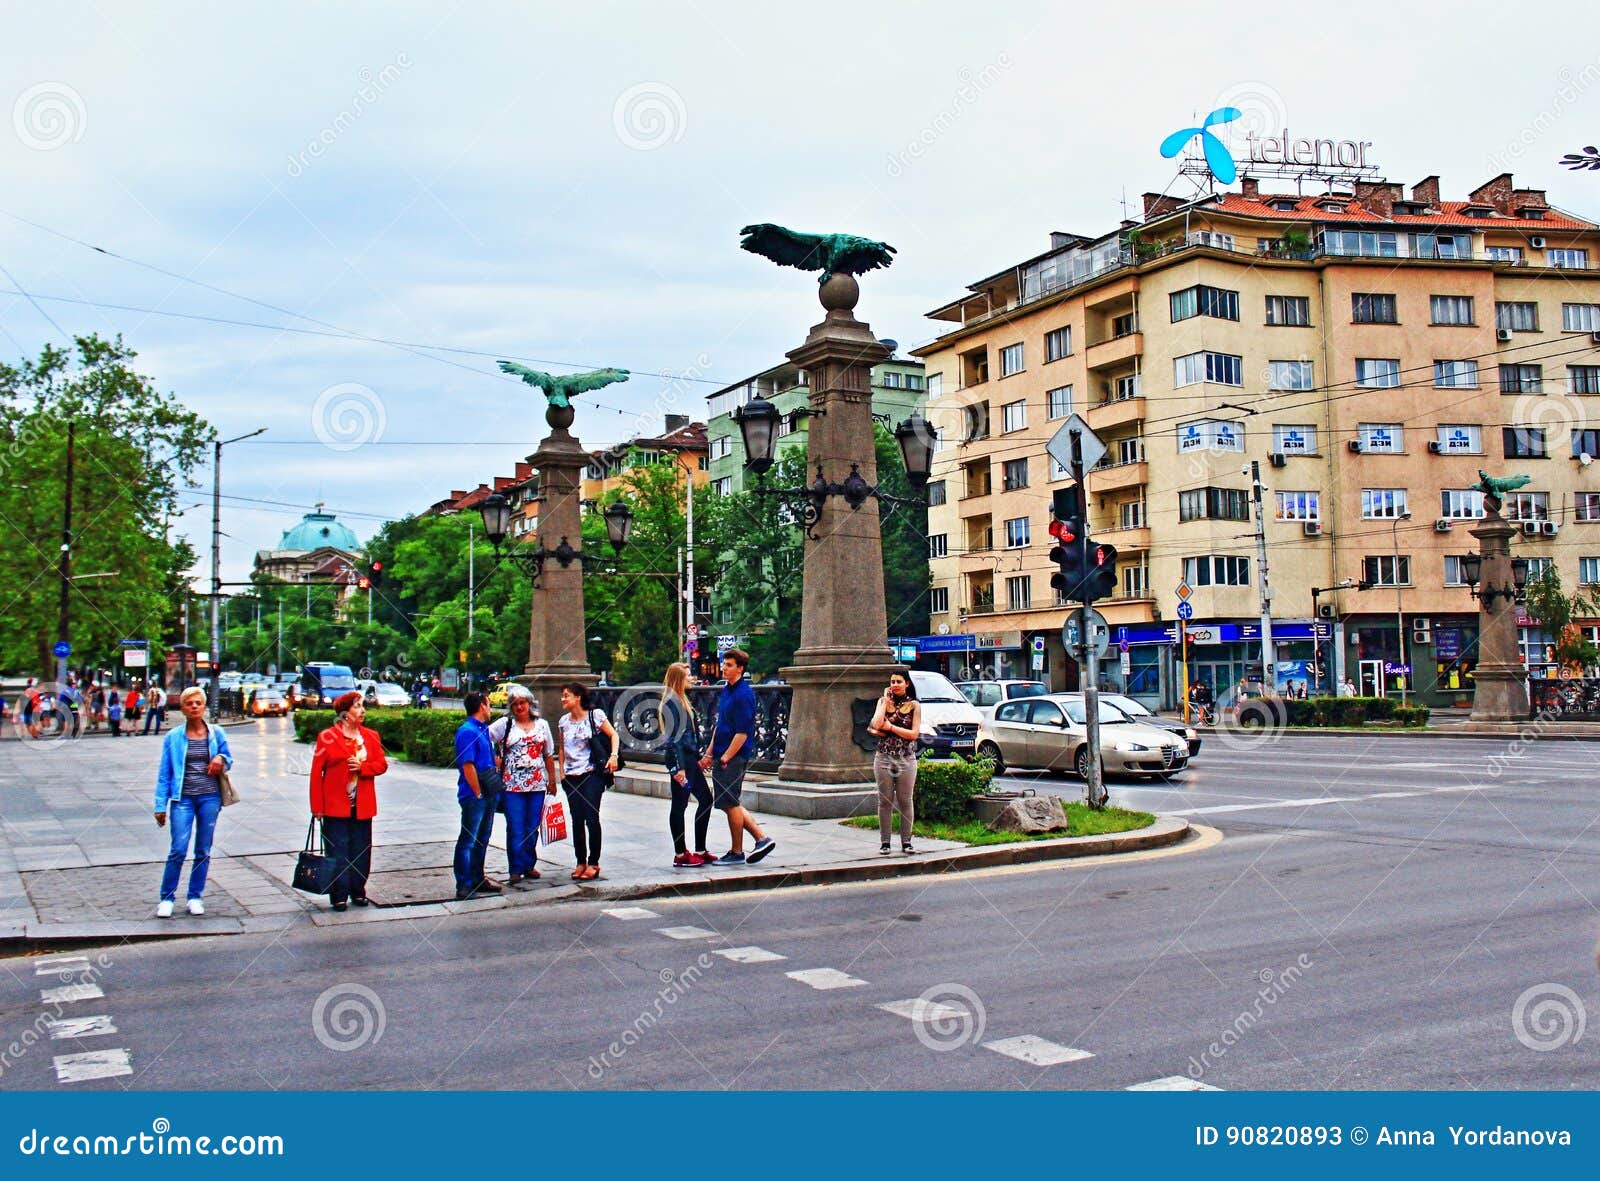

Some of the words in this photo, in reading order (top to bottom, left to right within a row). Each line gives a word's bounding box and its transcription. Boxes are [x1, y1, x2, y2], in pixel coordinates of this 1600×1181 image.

[1246, 128, 1372, 168] telenor
[1283, 440, 1305, 449] ДЗИ
[1370, 439, 1392, 448] ДЗИ
[1449, 440, 1470, 448] ДЗИ
